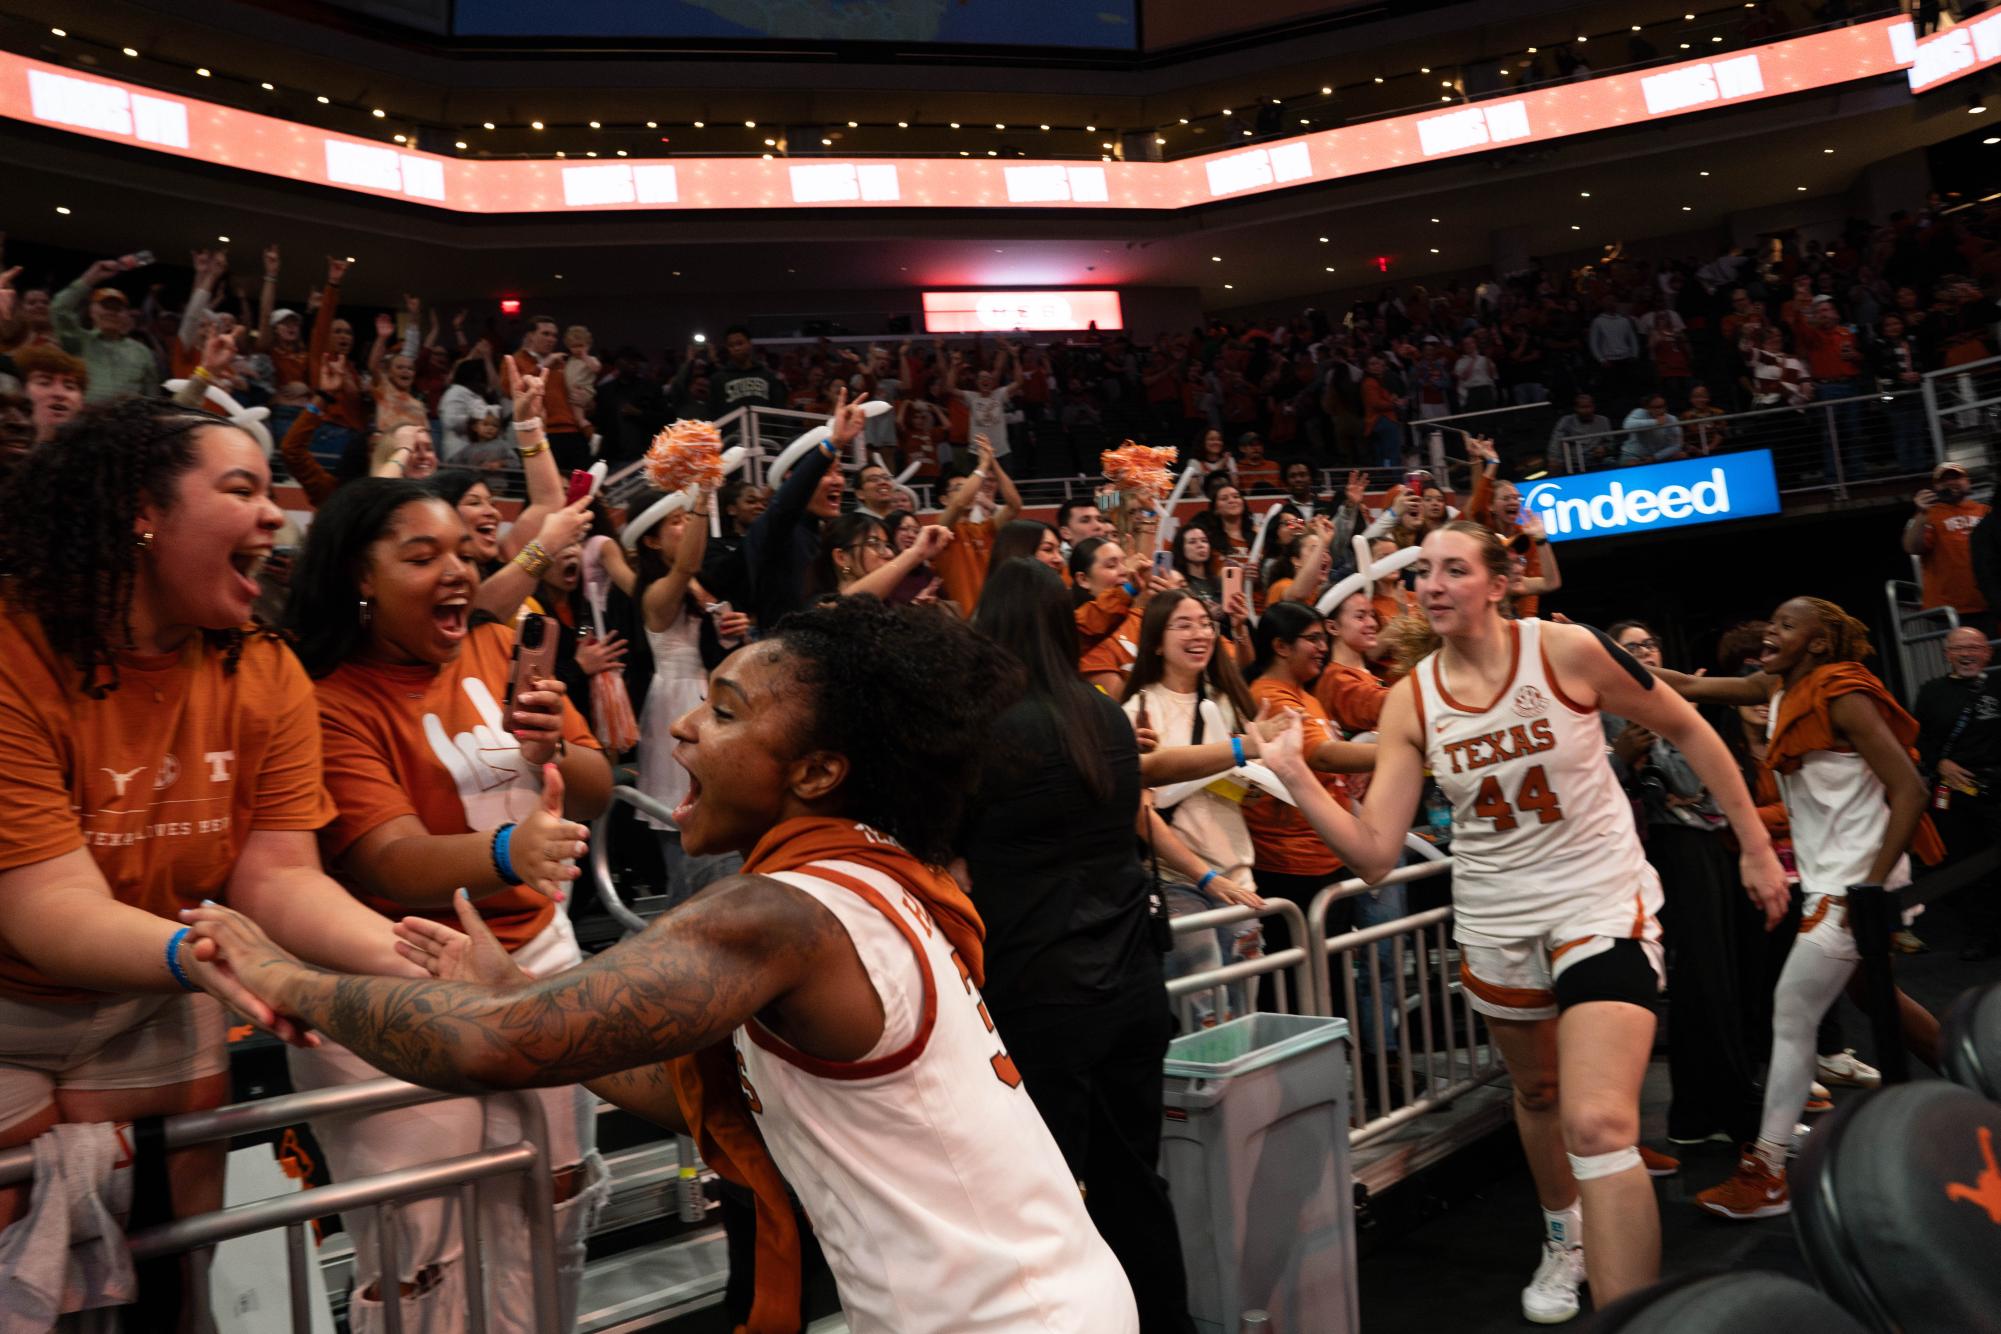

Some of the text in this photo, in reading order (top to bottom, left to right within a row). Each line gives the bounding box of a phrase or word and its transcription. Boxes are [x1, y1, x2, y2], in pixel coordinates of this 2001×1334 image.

[1537, 467, 1731, 535] indeed
[204, 750, 236, 782] T
[1442, 717, 1557, 774] TEXAS
[1473, 764, 1564, 832] 44
